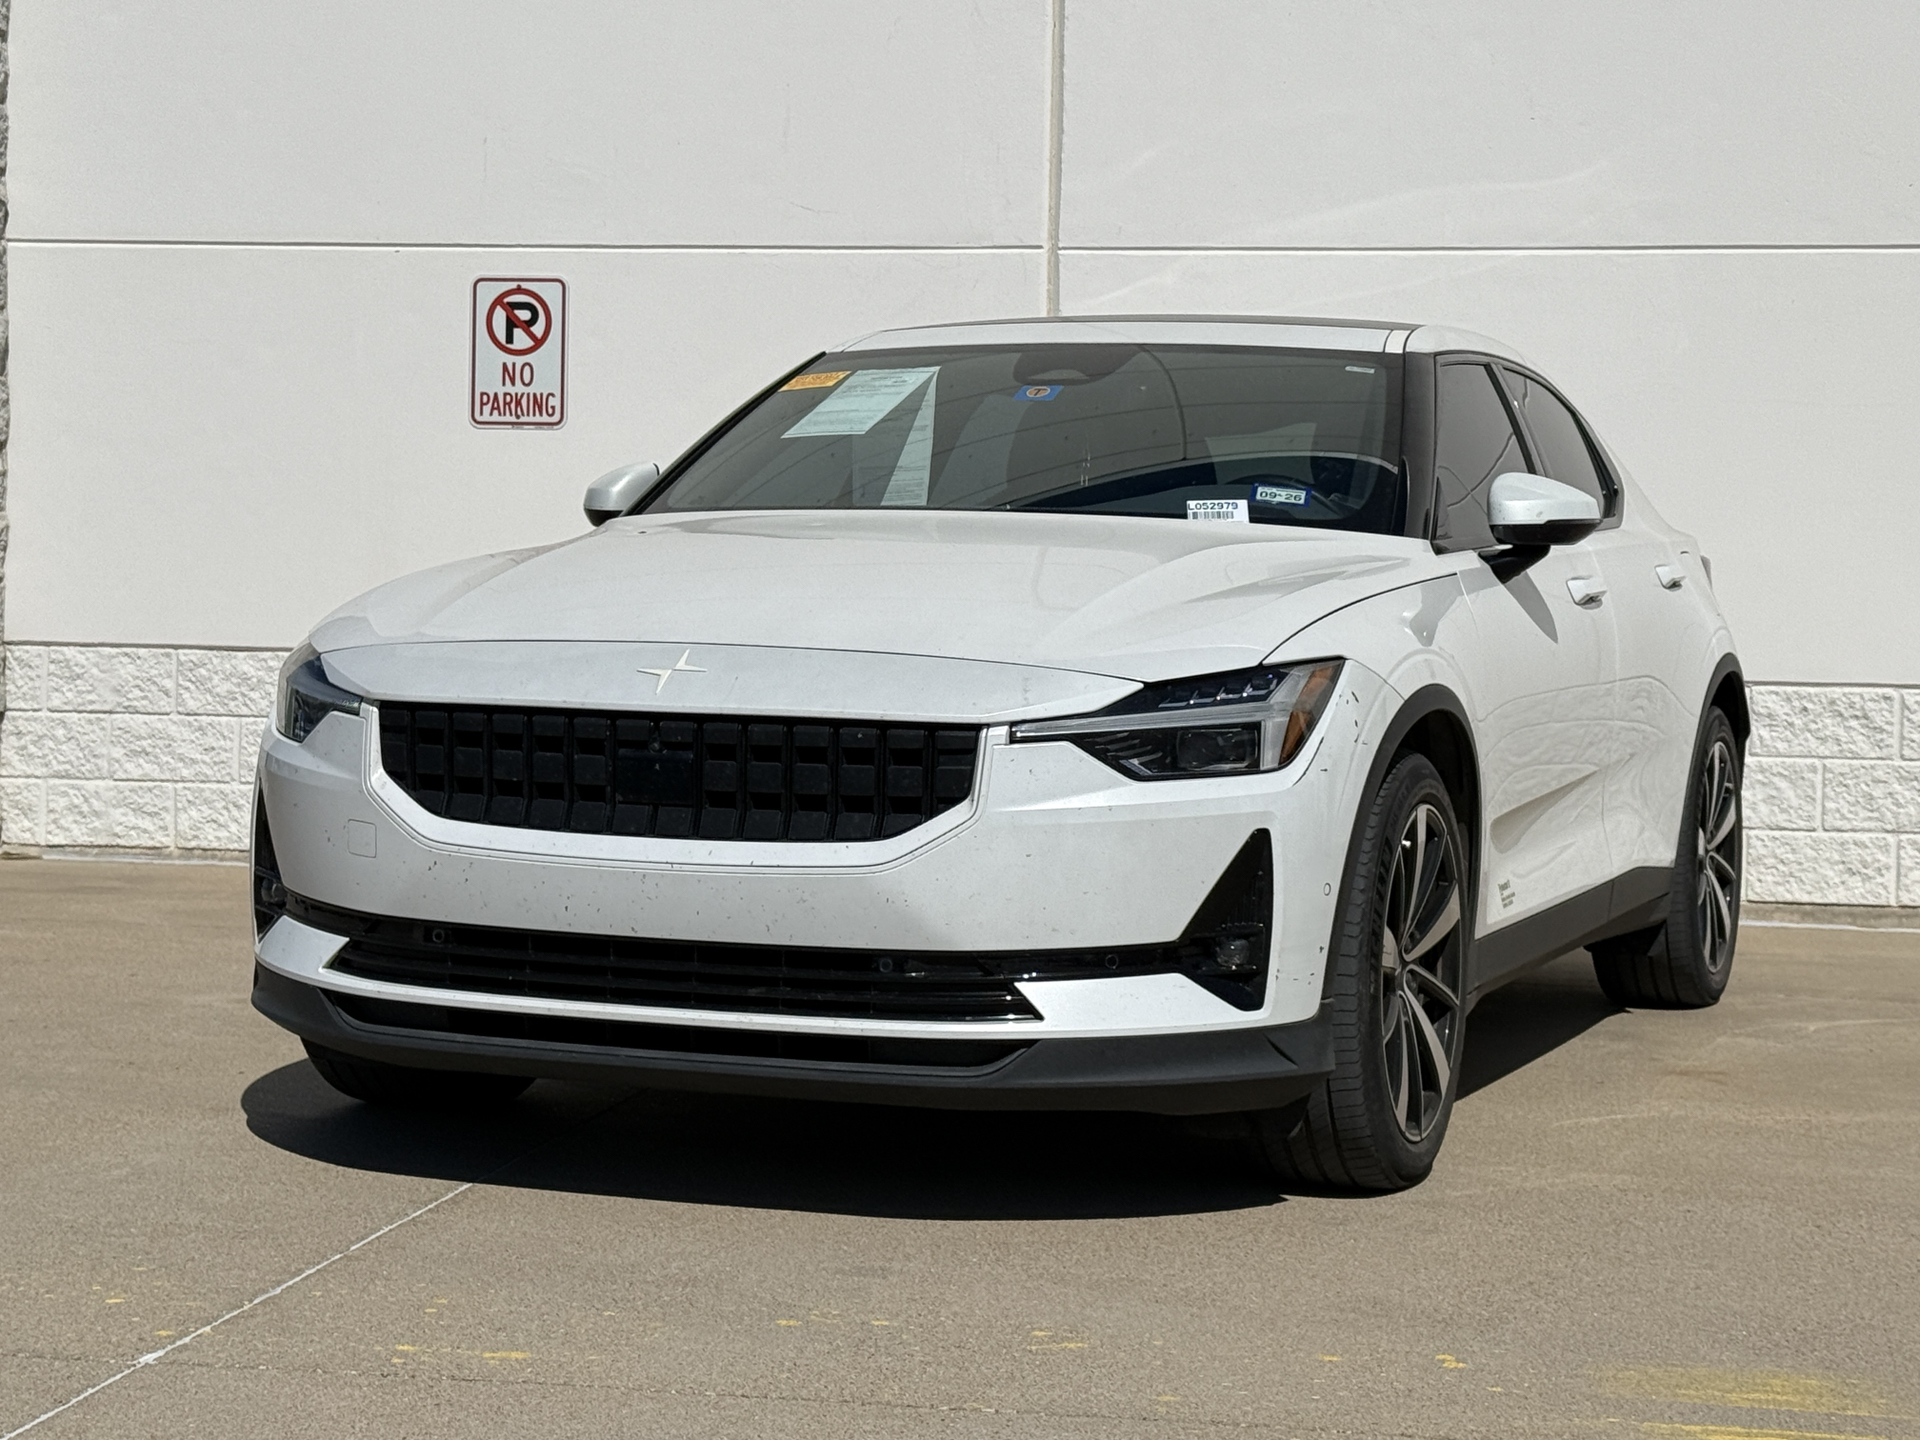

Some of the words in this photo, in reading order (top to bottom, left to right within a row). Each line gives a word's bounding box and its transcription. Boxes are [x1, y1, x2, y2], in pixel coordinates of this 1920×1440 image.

[505, 301, 539, 345] P
[501, 361, 535, 388] NO
[478, 391, 556, 418] PARKING
[1187, 501, 1239, 511] L052979
